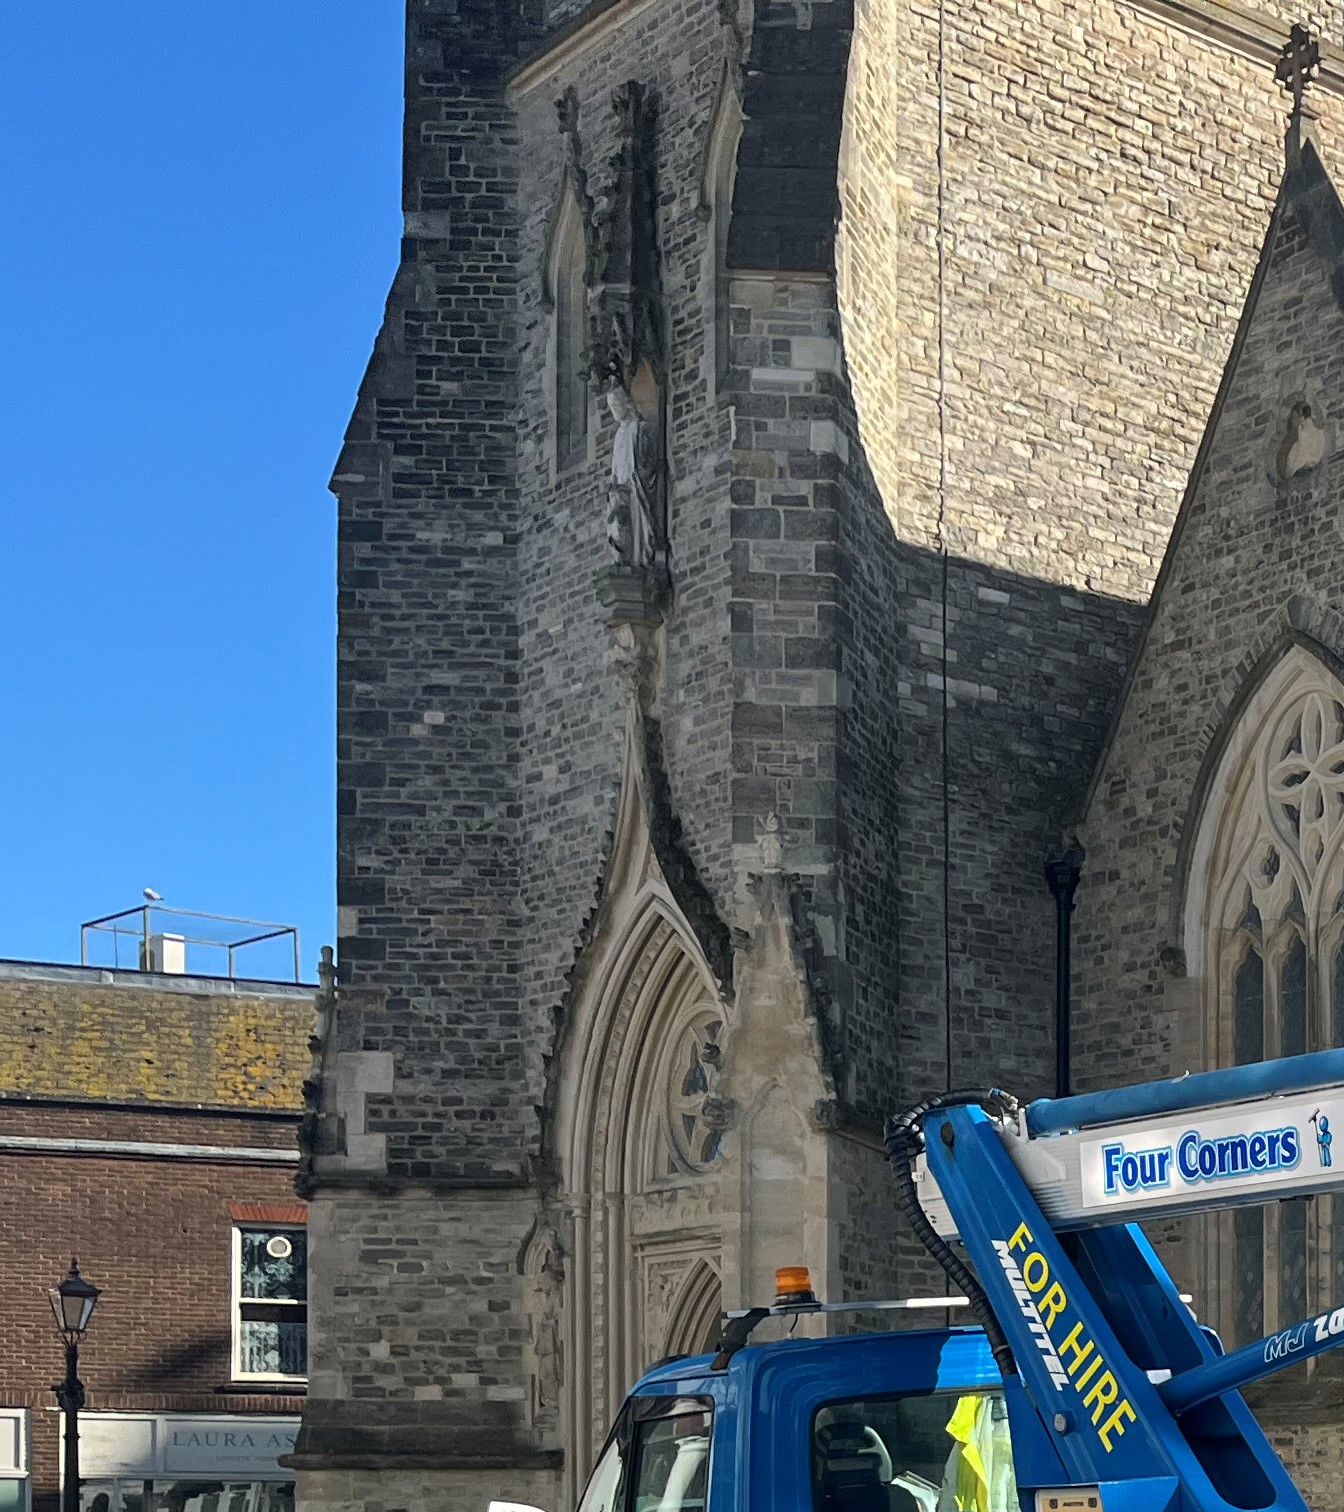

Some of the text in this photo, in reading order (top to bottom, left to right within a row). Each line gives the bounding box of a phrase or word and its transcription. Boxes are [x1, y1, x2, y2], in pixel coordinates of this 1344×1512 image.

[1104, 1129, 1299, 1192] Four Corners
[991, 1239, 1070, 1392] MULTITEL
[1008, 1221, 1136, 1453] FOR HIRE
[1264, 1322, 1310, 1363] MJ
[173, 1432, 255, 1447] LAURA
